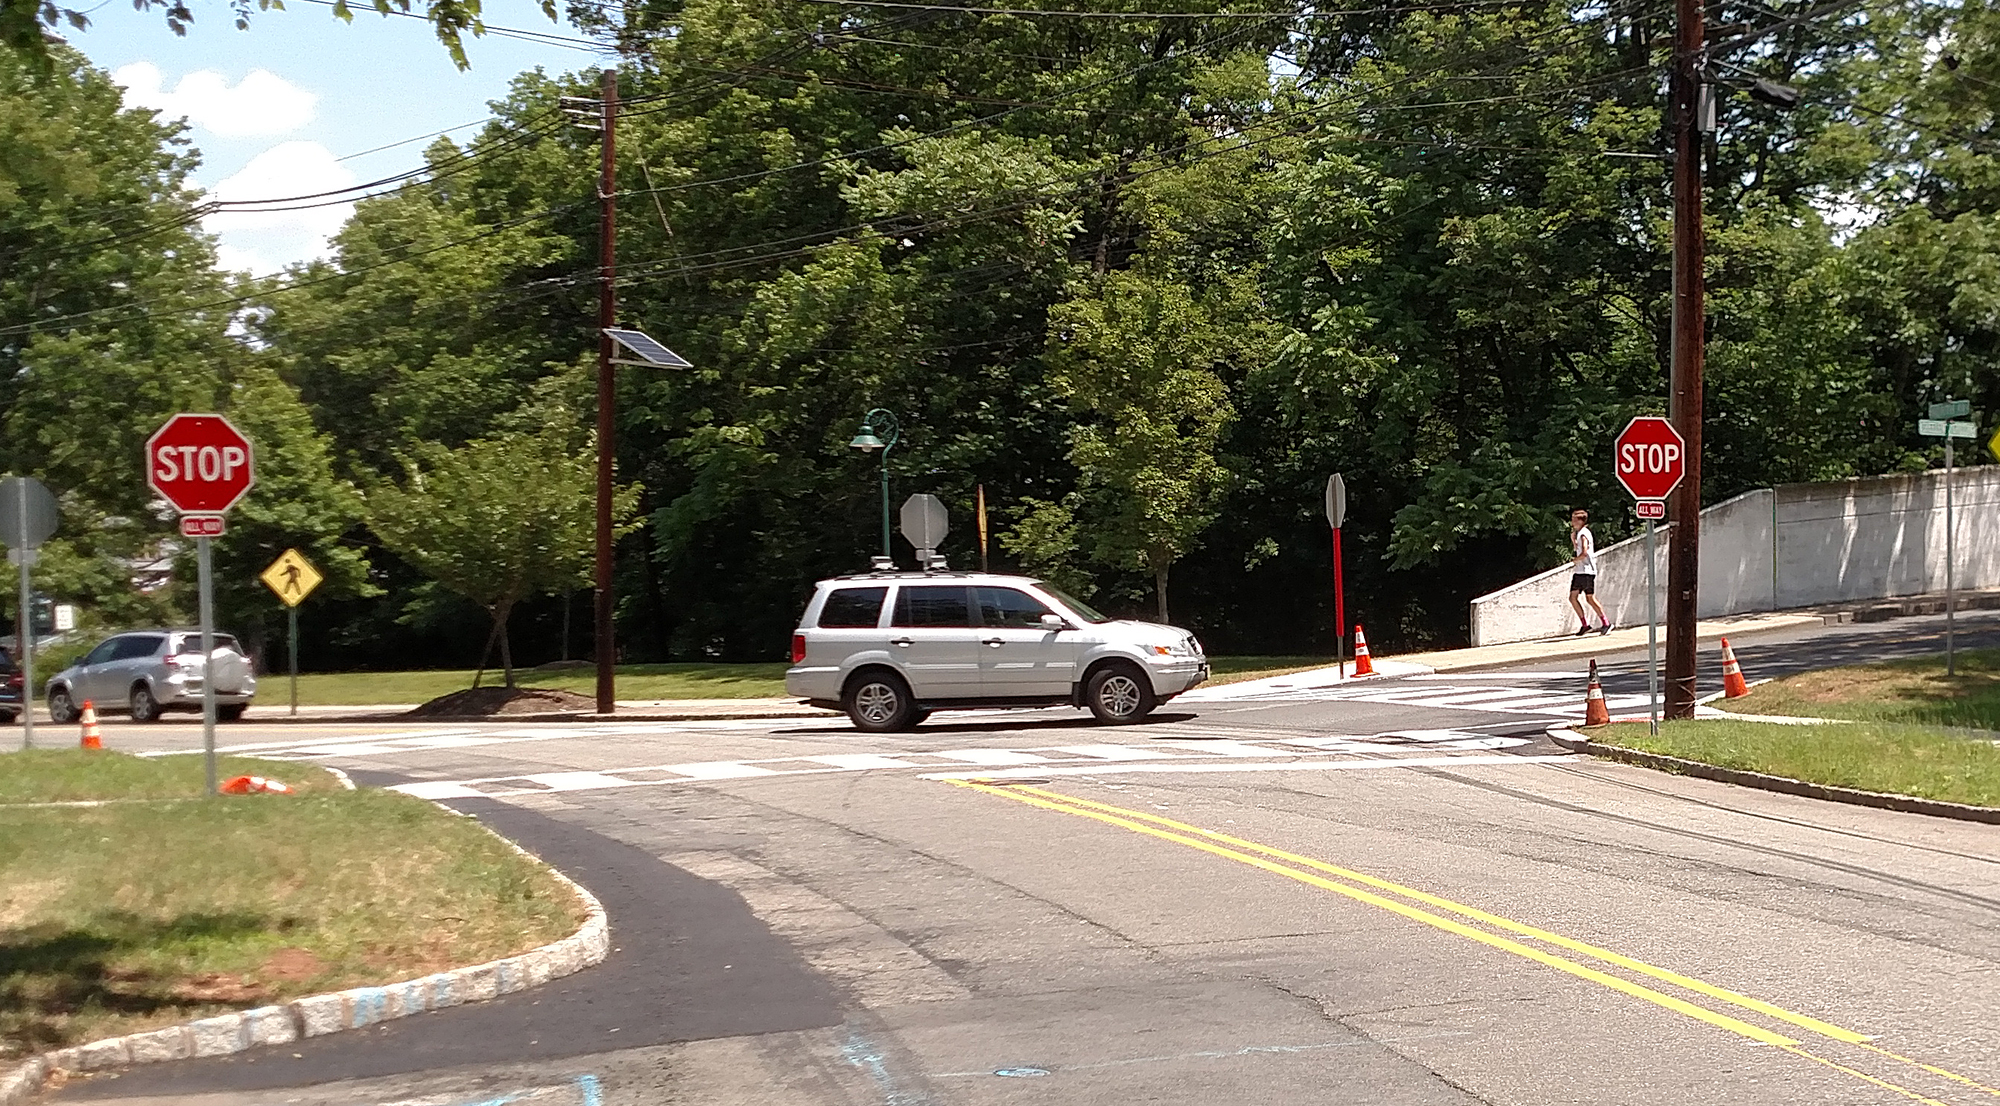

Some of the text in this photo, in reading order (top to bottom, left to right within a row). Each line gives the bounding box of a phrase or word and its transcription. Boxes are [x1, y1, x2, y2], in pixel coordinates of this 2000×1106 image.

[156, 445, 245, 482] STOP
[1620, 443, 1680, 474] STOP
[1638, 505, 1662, 515] ALL WAY
